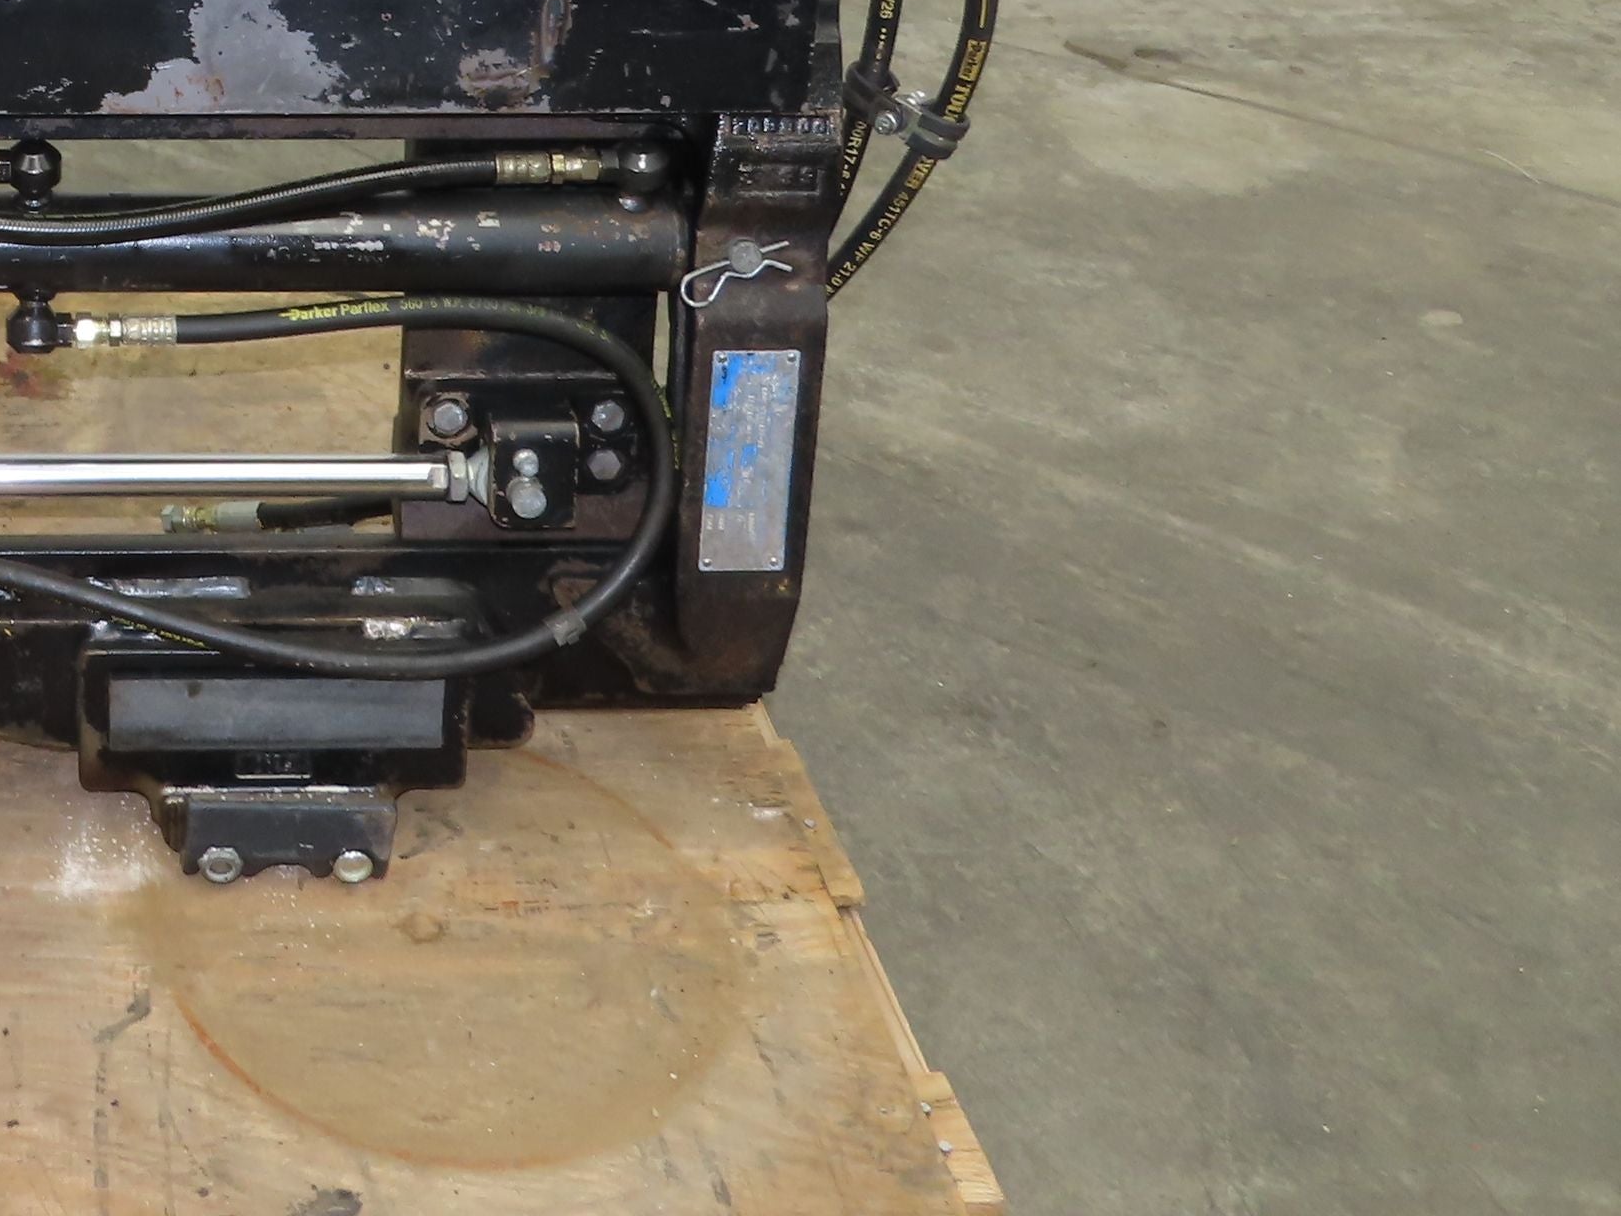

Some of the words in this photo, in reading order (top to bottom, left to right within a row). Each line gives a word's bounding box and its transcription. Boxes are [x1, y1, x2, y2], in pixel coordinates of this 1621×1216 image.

[961, 40, 985, 81] Parker
[943, 83, 972, 124] TOU
[281, 303, 338, 322] Parker
[340, 299, 390, 317] Parflex
